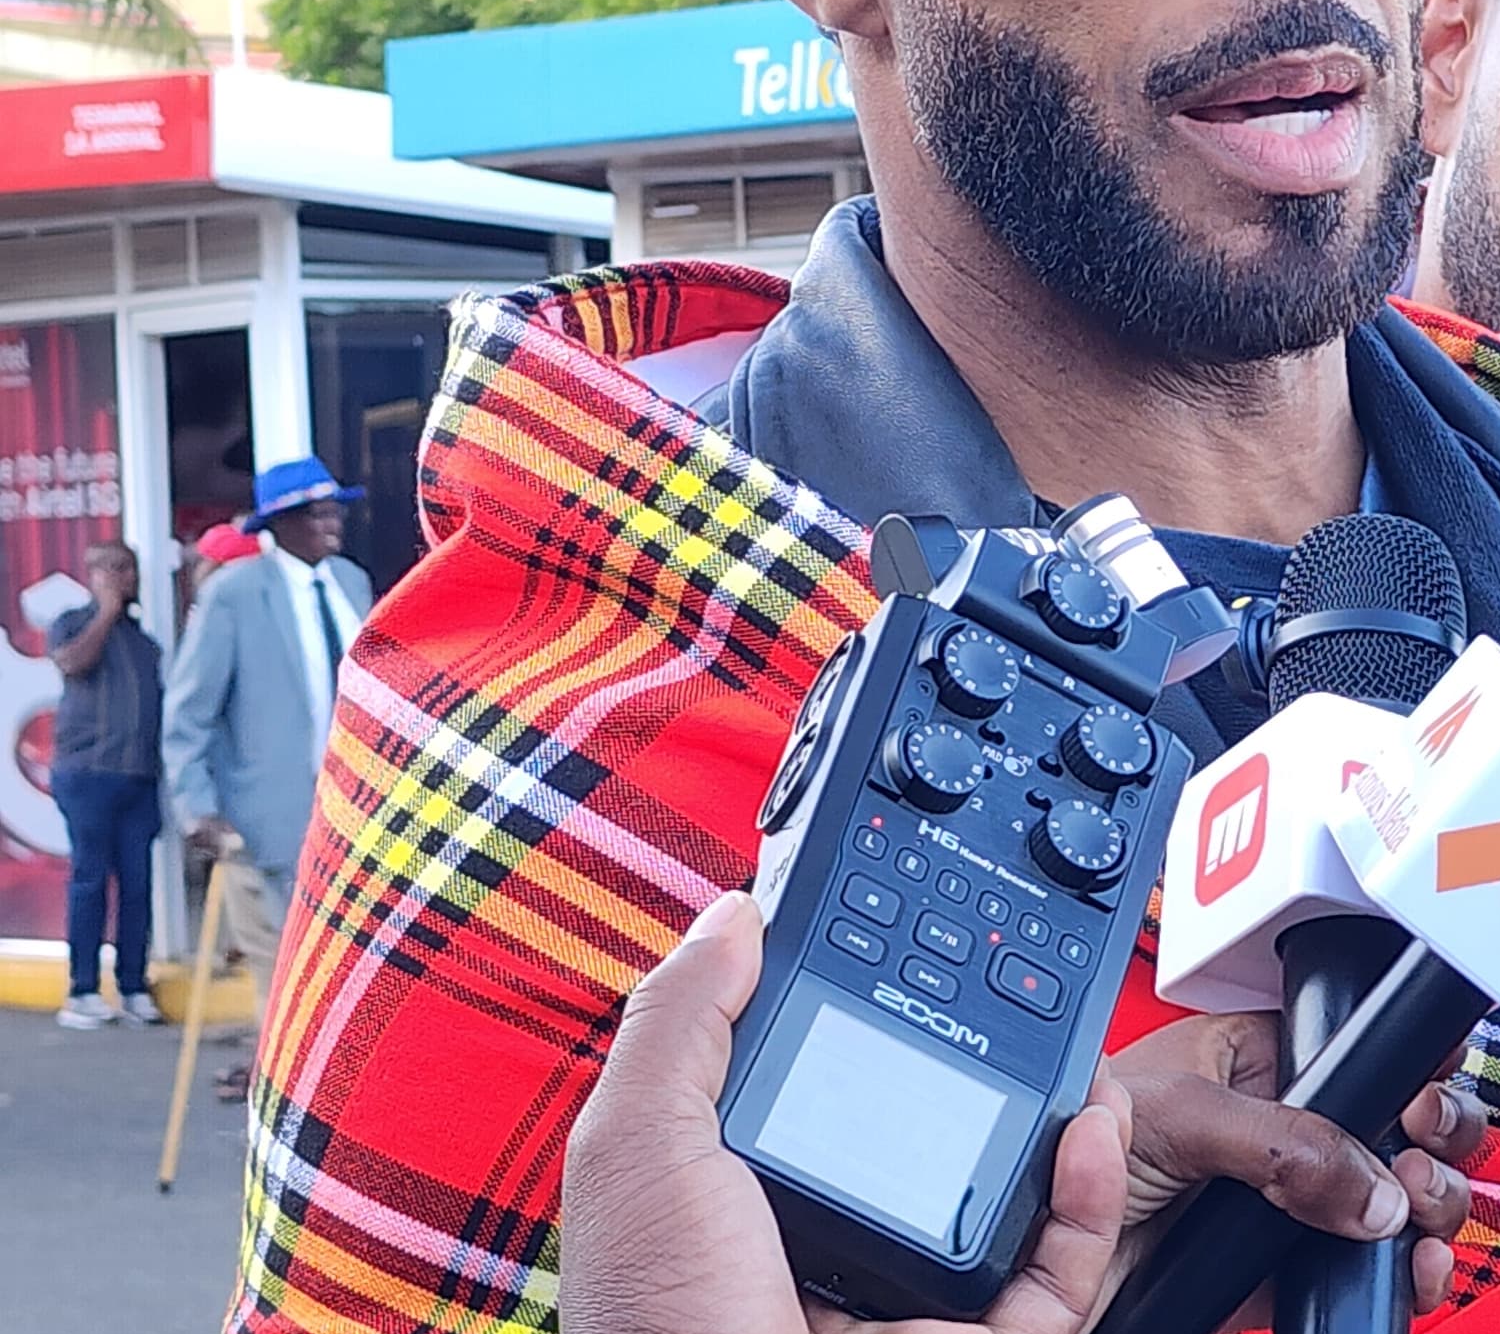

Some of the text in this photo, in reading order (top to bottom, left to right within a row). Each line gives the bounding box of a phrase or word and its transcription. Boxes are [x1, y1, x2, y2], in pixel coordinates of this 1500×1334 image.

[917, 818, 961, 852] H6
[864, 834, 875, 849] L
[988, 901, 999, 915] 2
[1028, 922, 1040, 936] 3
[1068, 945, 1079, 959] 4
